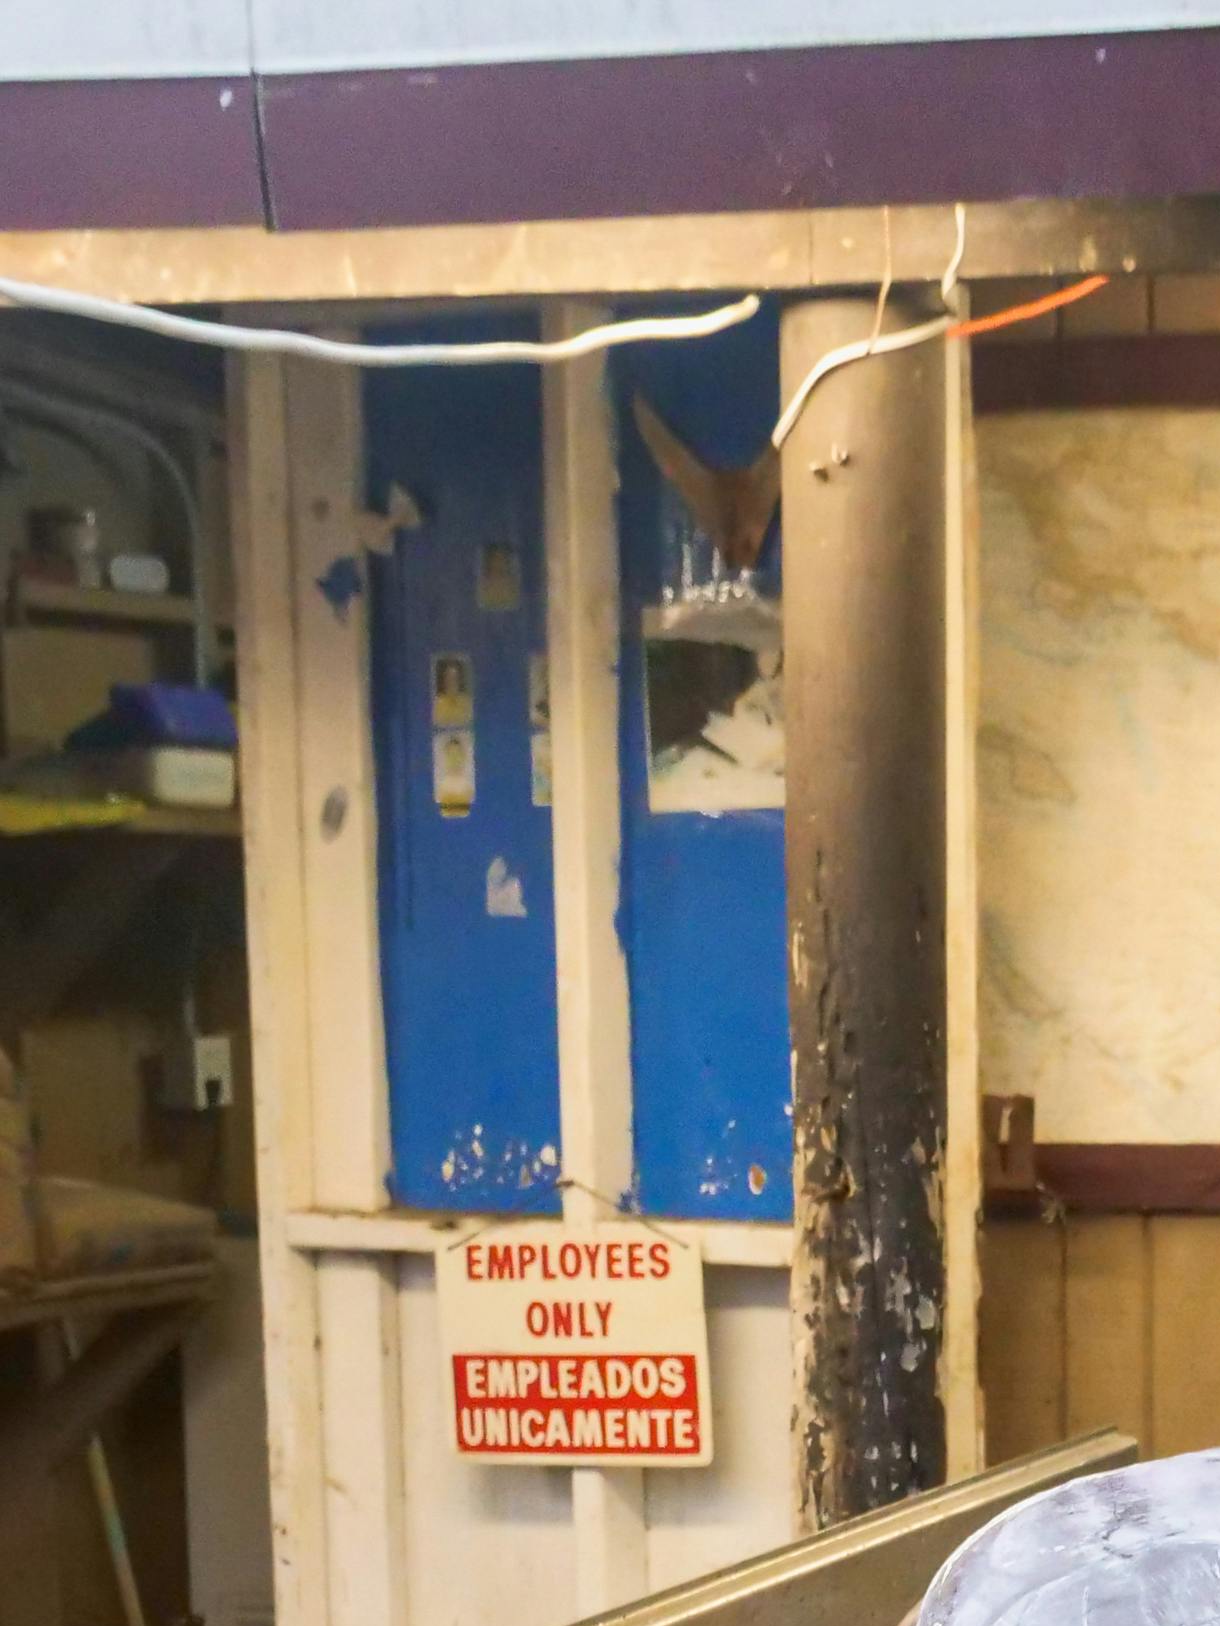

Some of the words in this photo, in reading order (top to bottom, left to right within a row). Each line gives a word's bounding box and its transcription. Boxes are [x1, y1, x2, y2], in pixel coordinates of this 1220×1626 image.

[466, 1243, 671, 1280] EMPLOYEES
[526, 1301, 612, 1338] ONLY
[466, 1358, 686, 1398] EMPLEADOS
[461, 1408, 695, 1448] UNICAMENTE
